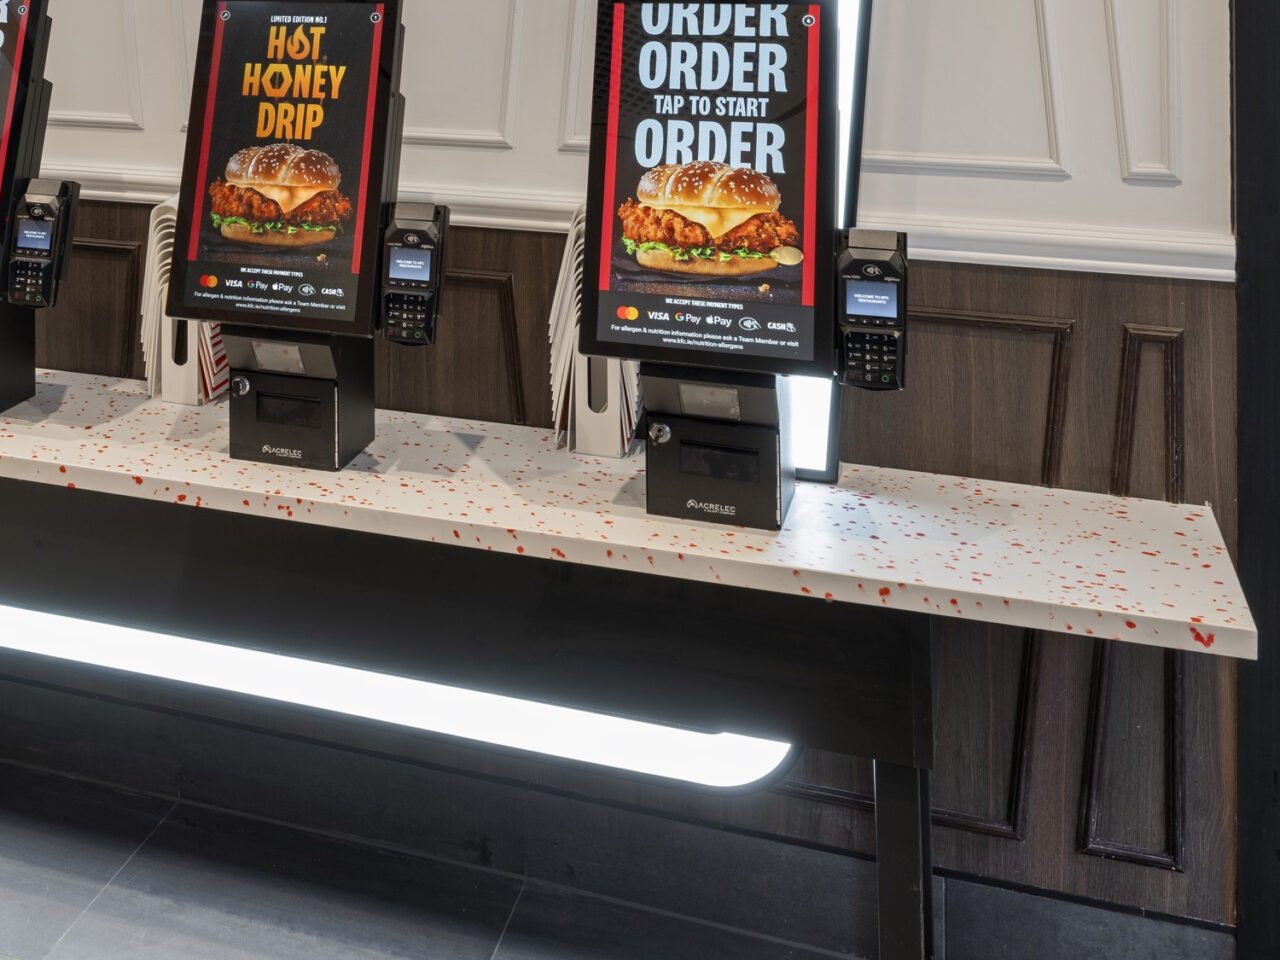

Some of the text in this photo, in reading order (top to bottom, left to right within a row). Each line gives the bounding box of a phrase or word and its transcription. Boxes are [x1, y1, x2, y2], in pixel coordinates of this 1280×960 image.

[267, 24, 326, 60] HOT
[638, 41, 788, 92] ORDER
[242, 62, 346, 100] HONEY
[654, 94, 769, 117] TAP TO START
[256, 102, 324, 140] DRIP
[634, 118, 786, 174] ORDER
[225, 279, 242, 287] VISA
[255, 281, 268, 291] Pay
[647, 310, 669, 321] VISA
[686, 314, 701, 325] Pay
[714, 316, 732, 328] Pay
[767, 322, 786, 330] CASH
[663, 337, 744, 350] www.kfc.ie/nutrition-allergens
[272, 448, 302, 457] ACRELEC
[699, 502, 736, 513] ACRELEC
